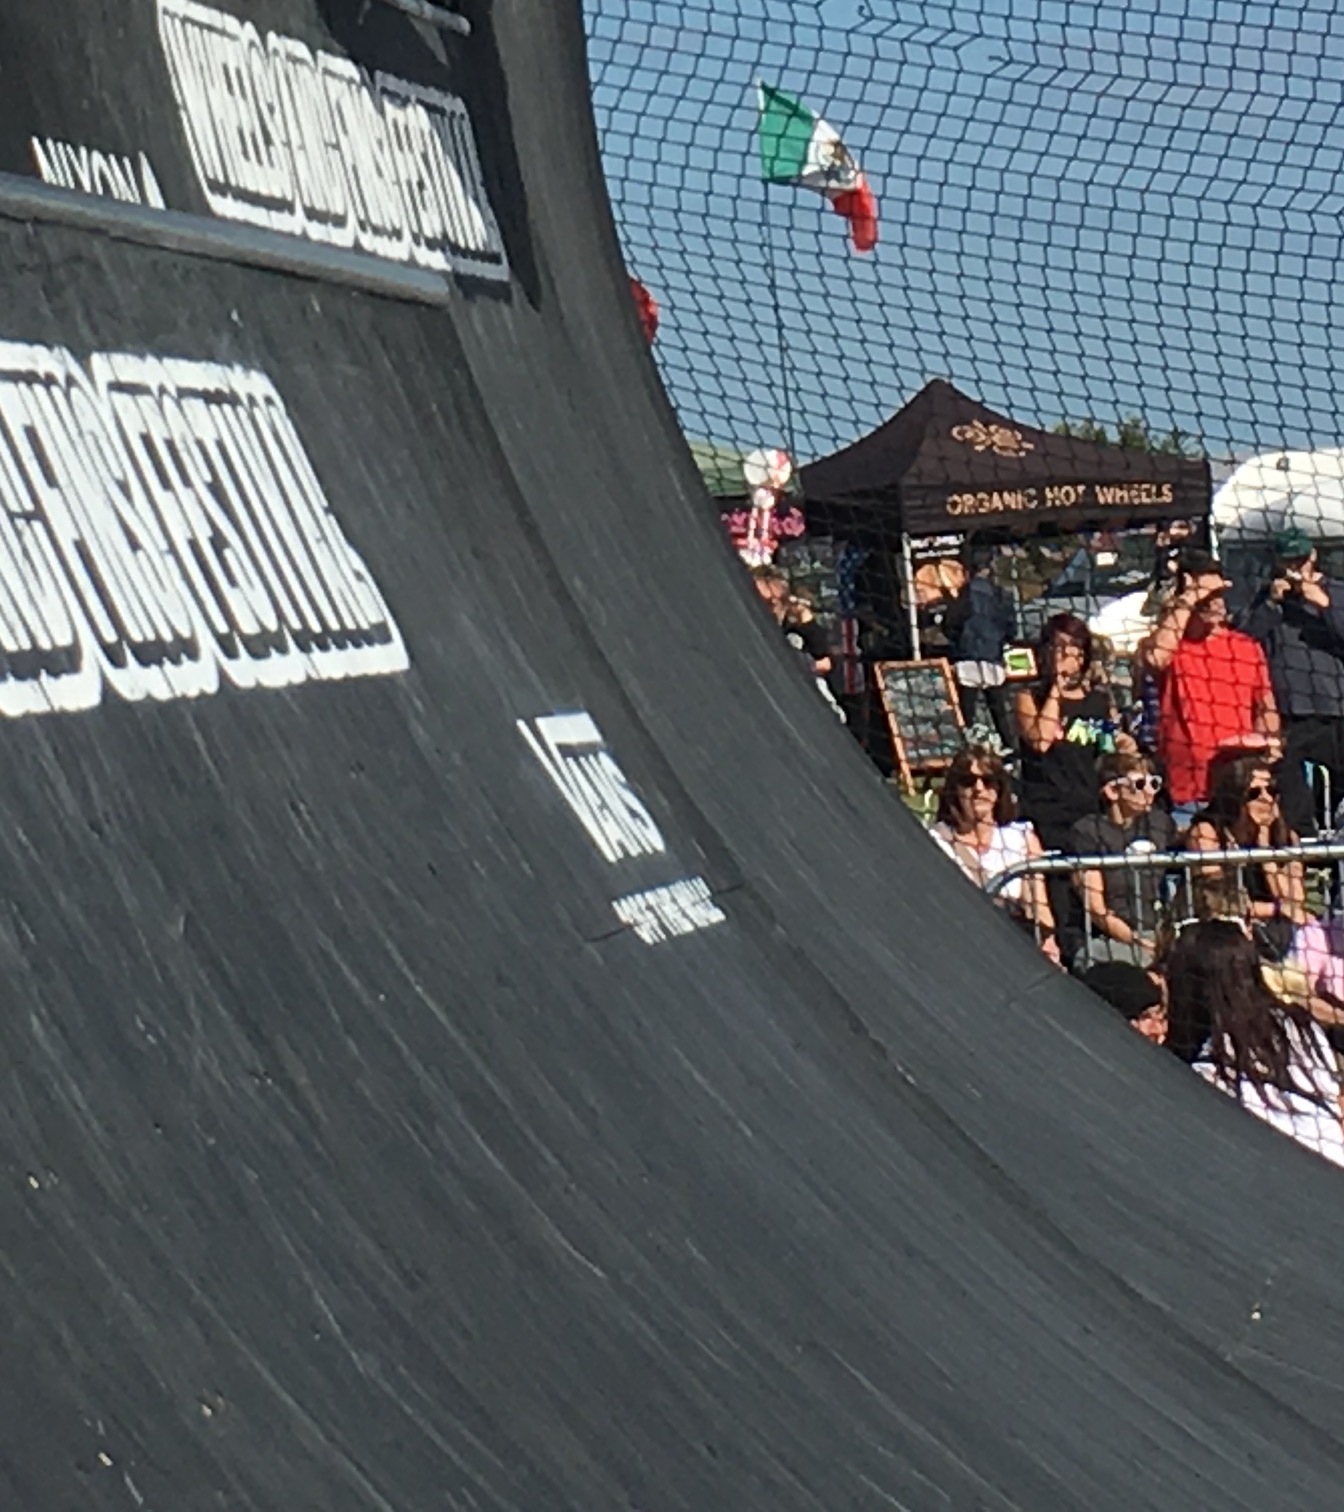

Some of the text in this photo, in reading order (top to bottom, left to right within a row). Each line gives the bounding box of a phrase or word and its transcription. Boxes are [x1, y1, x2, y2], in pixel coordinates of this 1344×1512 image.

[99, 378, 396, 656] FESTIVAL
[946, 488, 1038, 515] ORGANIC
[1095, 483, 1174, 506] WHEELS
[516, 710, 666, 864] VANS
